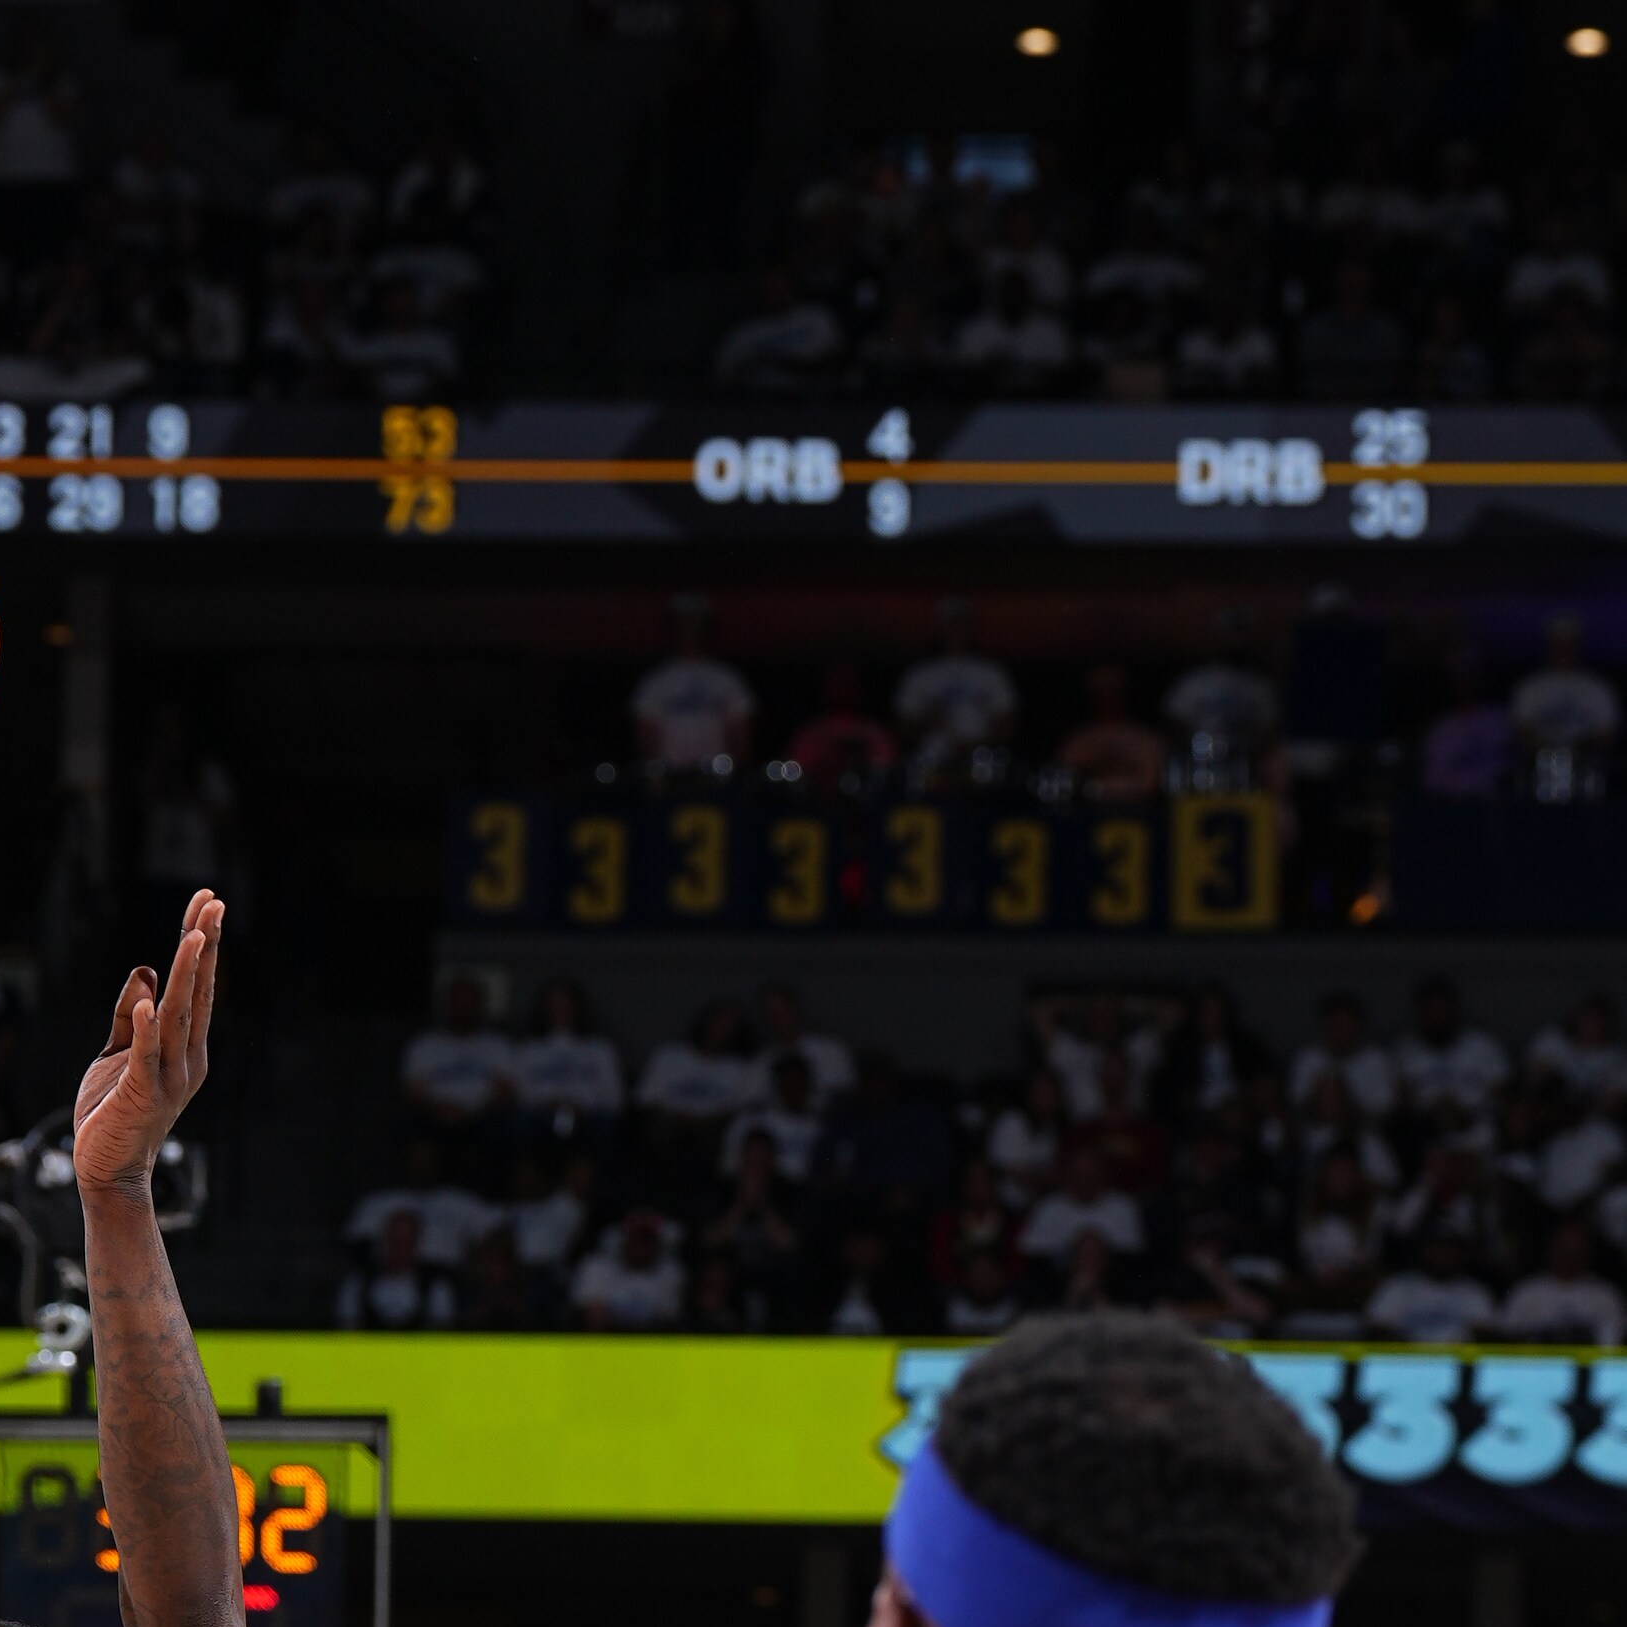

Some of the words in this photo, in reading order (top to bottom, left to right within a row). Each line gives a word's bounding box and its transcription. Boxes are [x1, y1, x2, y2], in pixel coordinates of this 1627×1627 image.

[47, 402, 113, 461] 21
[868, 409, 913, 464] 4
[1352, 409, 1429, 466] 25
[694, 438, 842, 503] ORB
[1177, 438, 1325, 505] DRB
[47, 472, 123, 532] 29
[869, 478, 910, 537] 9
[1351, 479, 1429, 539] 30
